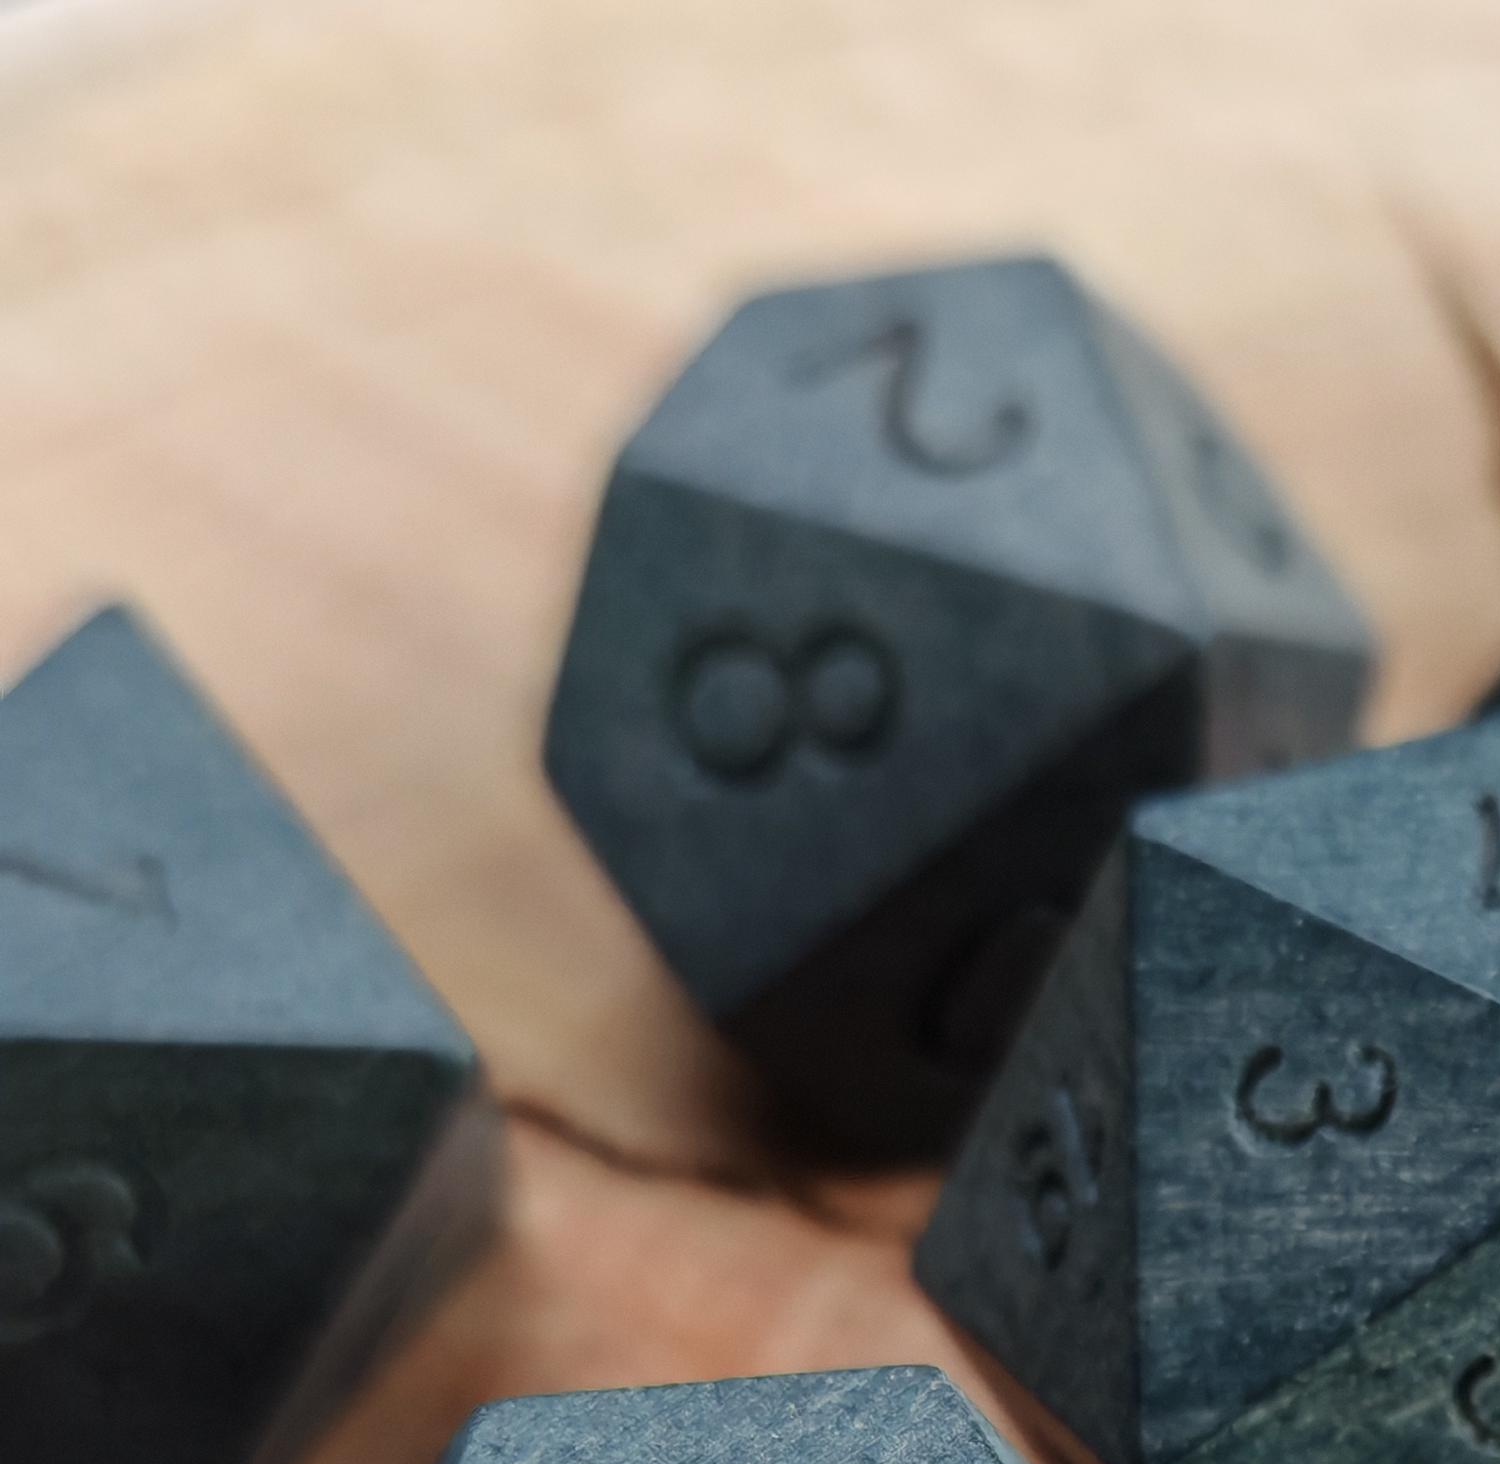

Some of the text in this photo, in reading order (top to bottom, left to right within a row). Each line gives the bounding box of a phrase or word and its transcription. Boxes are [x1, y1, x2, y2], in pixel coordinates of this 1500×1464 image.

[787, 314, 1040, 482] 2
[658, 613, 905, 788] 8
[1232, 1042, 1399, 1149] 3
